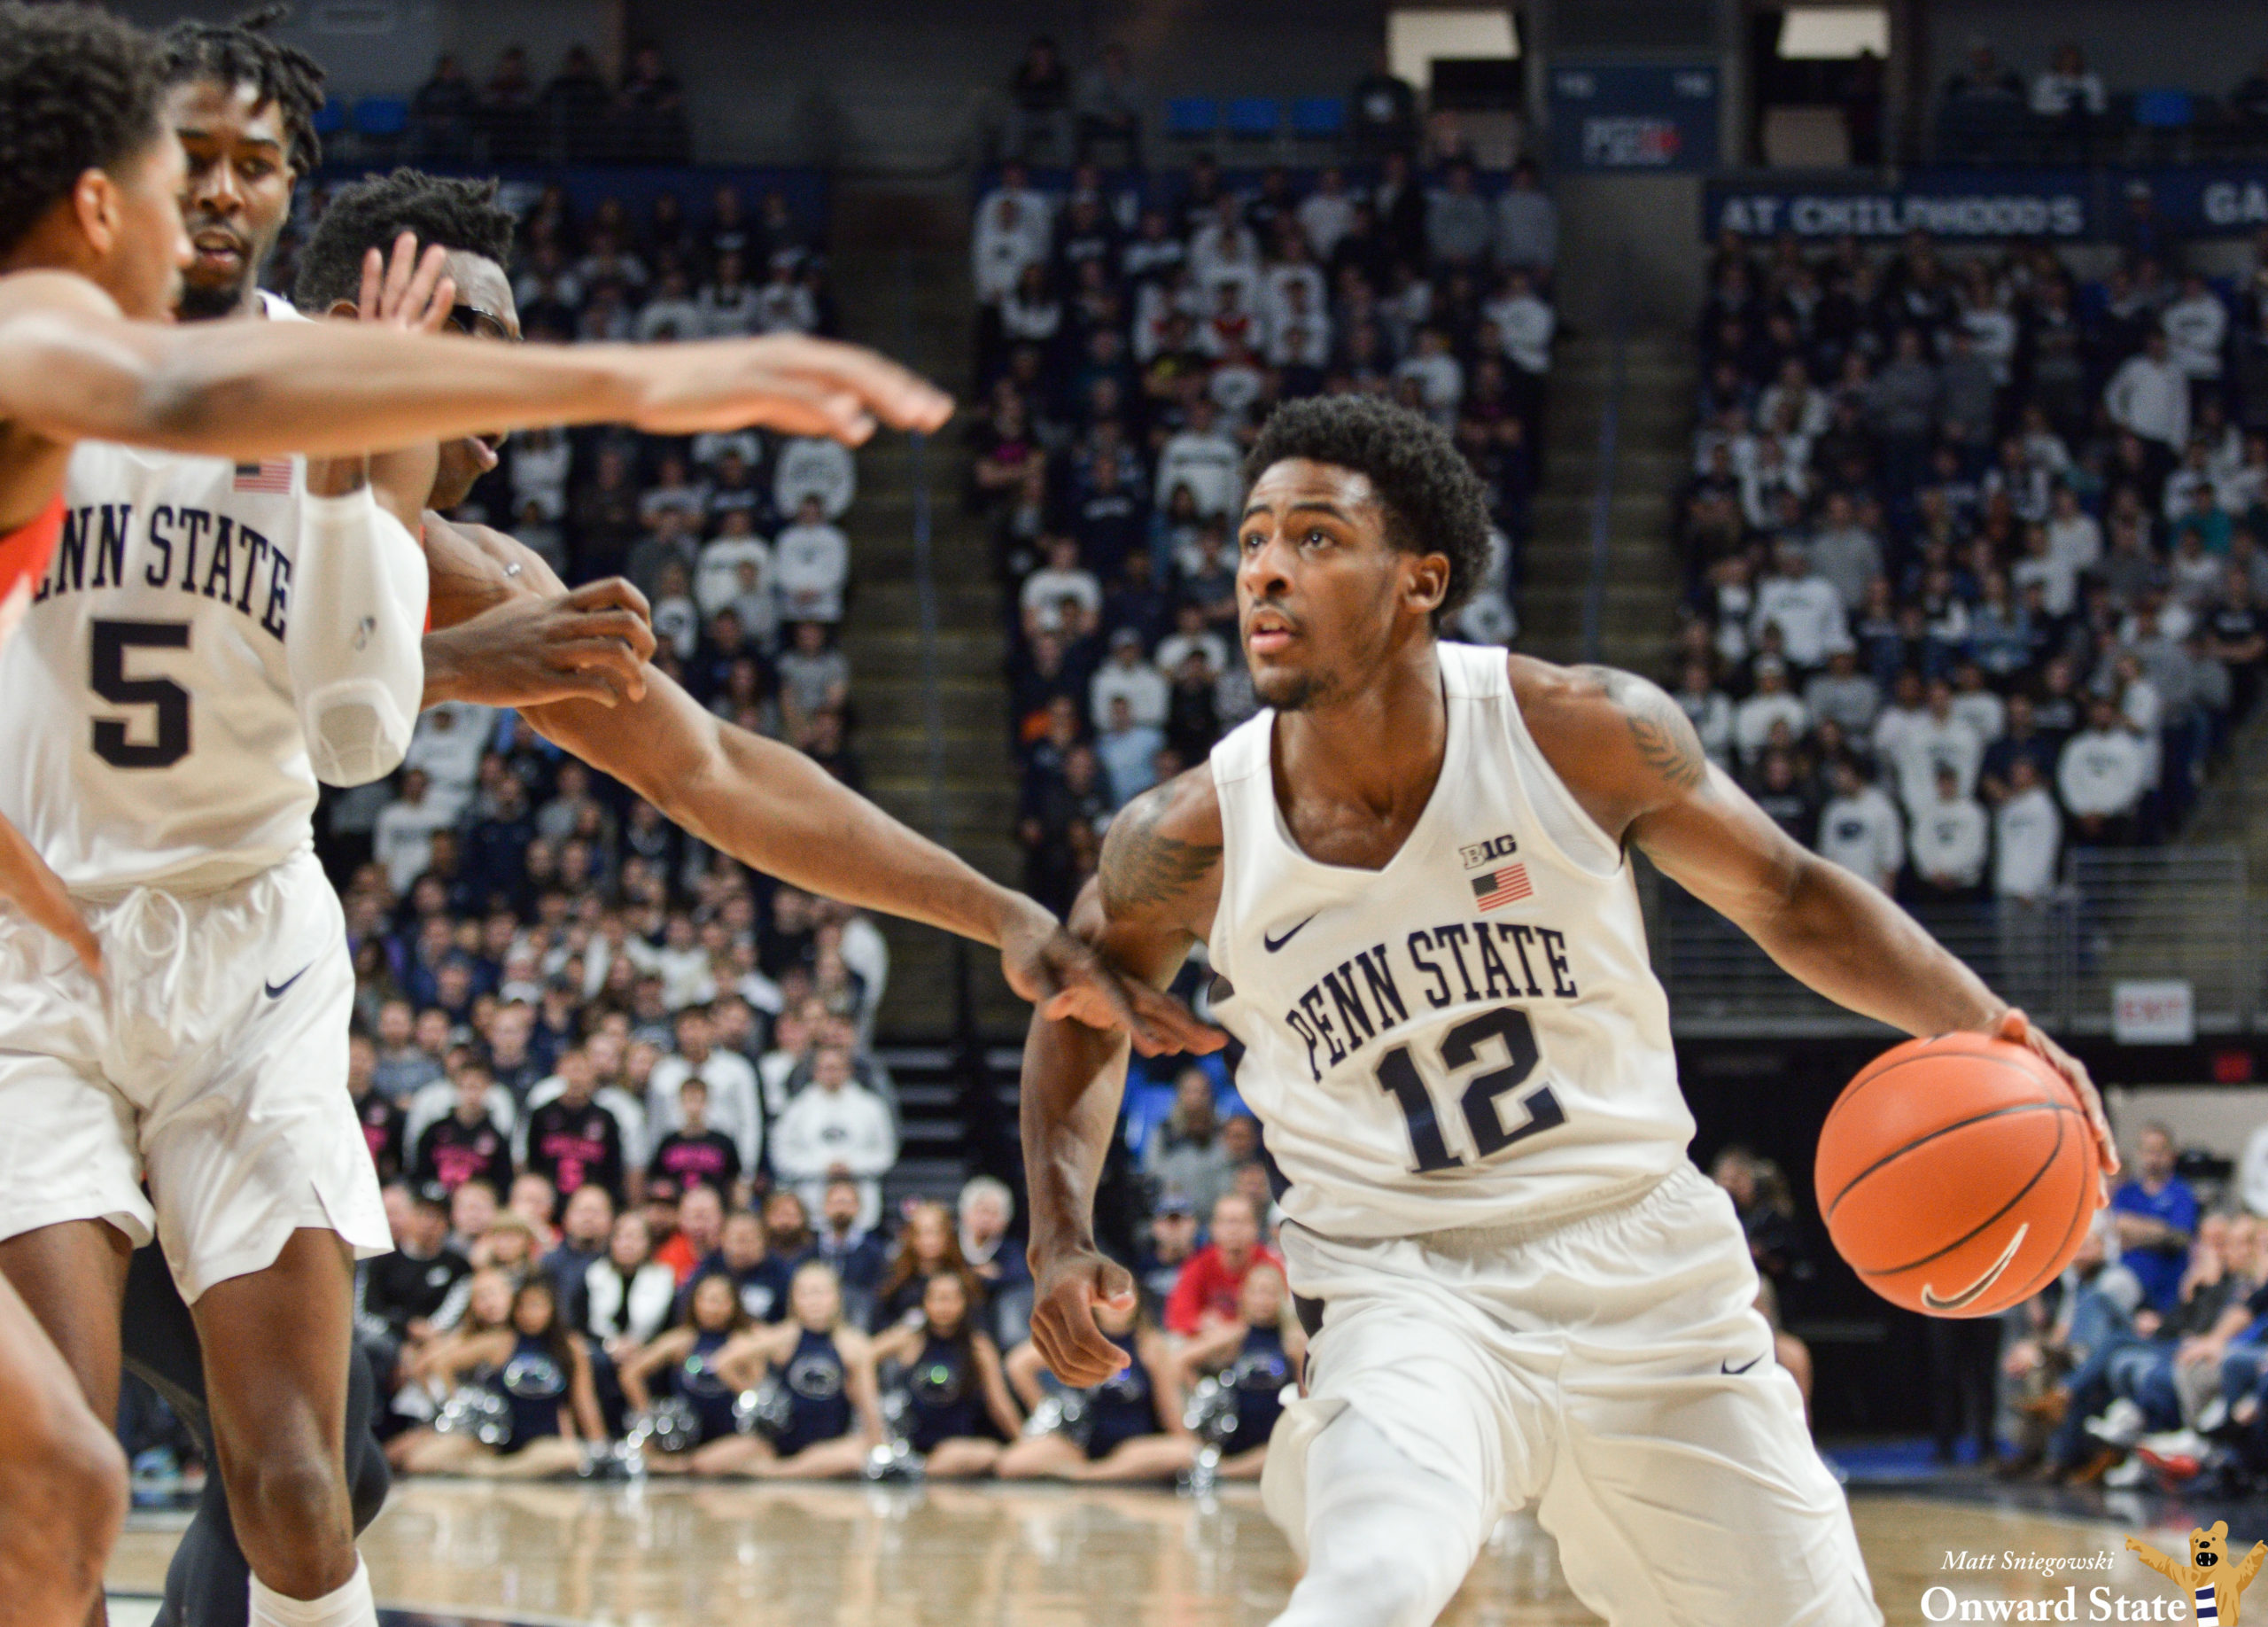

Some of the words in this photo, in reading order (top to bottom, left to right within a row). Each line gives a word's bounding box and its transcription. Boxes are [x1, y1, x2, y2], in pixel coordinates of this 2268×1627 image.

[1720, 196, 1777, 234] AT
[35, 503, 132, 605] NN
[145, 504, 292, 644] STATE
[90, 619, 191, 769] 5
[1285, 943, 1410, 1085] PENN
[1407, 922, 1579, 1009] STATE
[1372, 1006, 1569, 1173] 12
